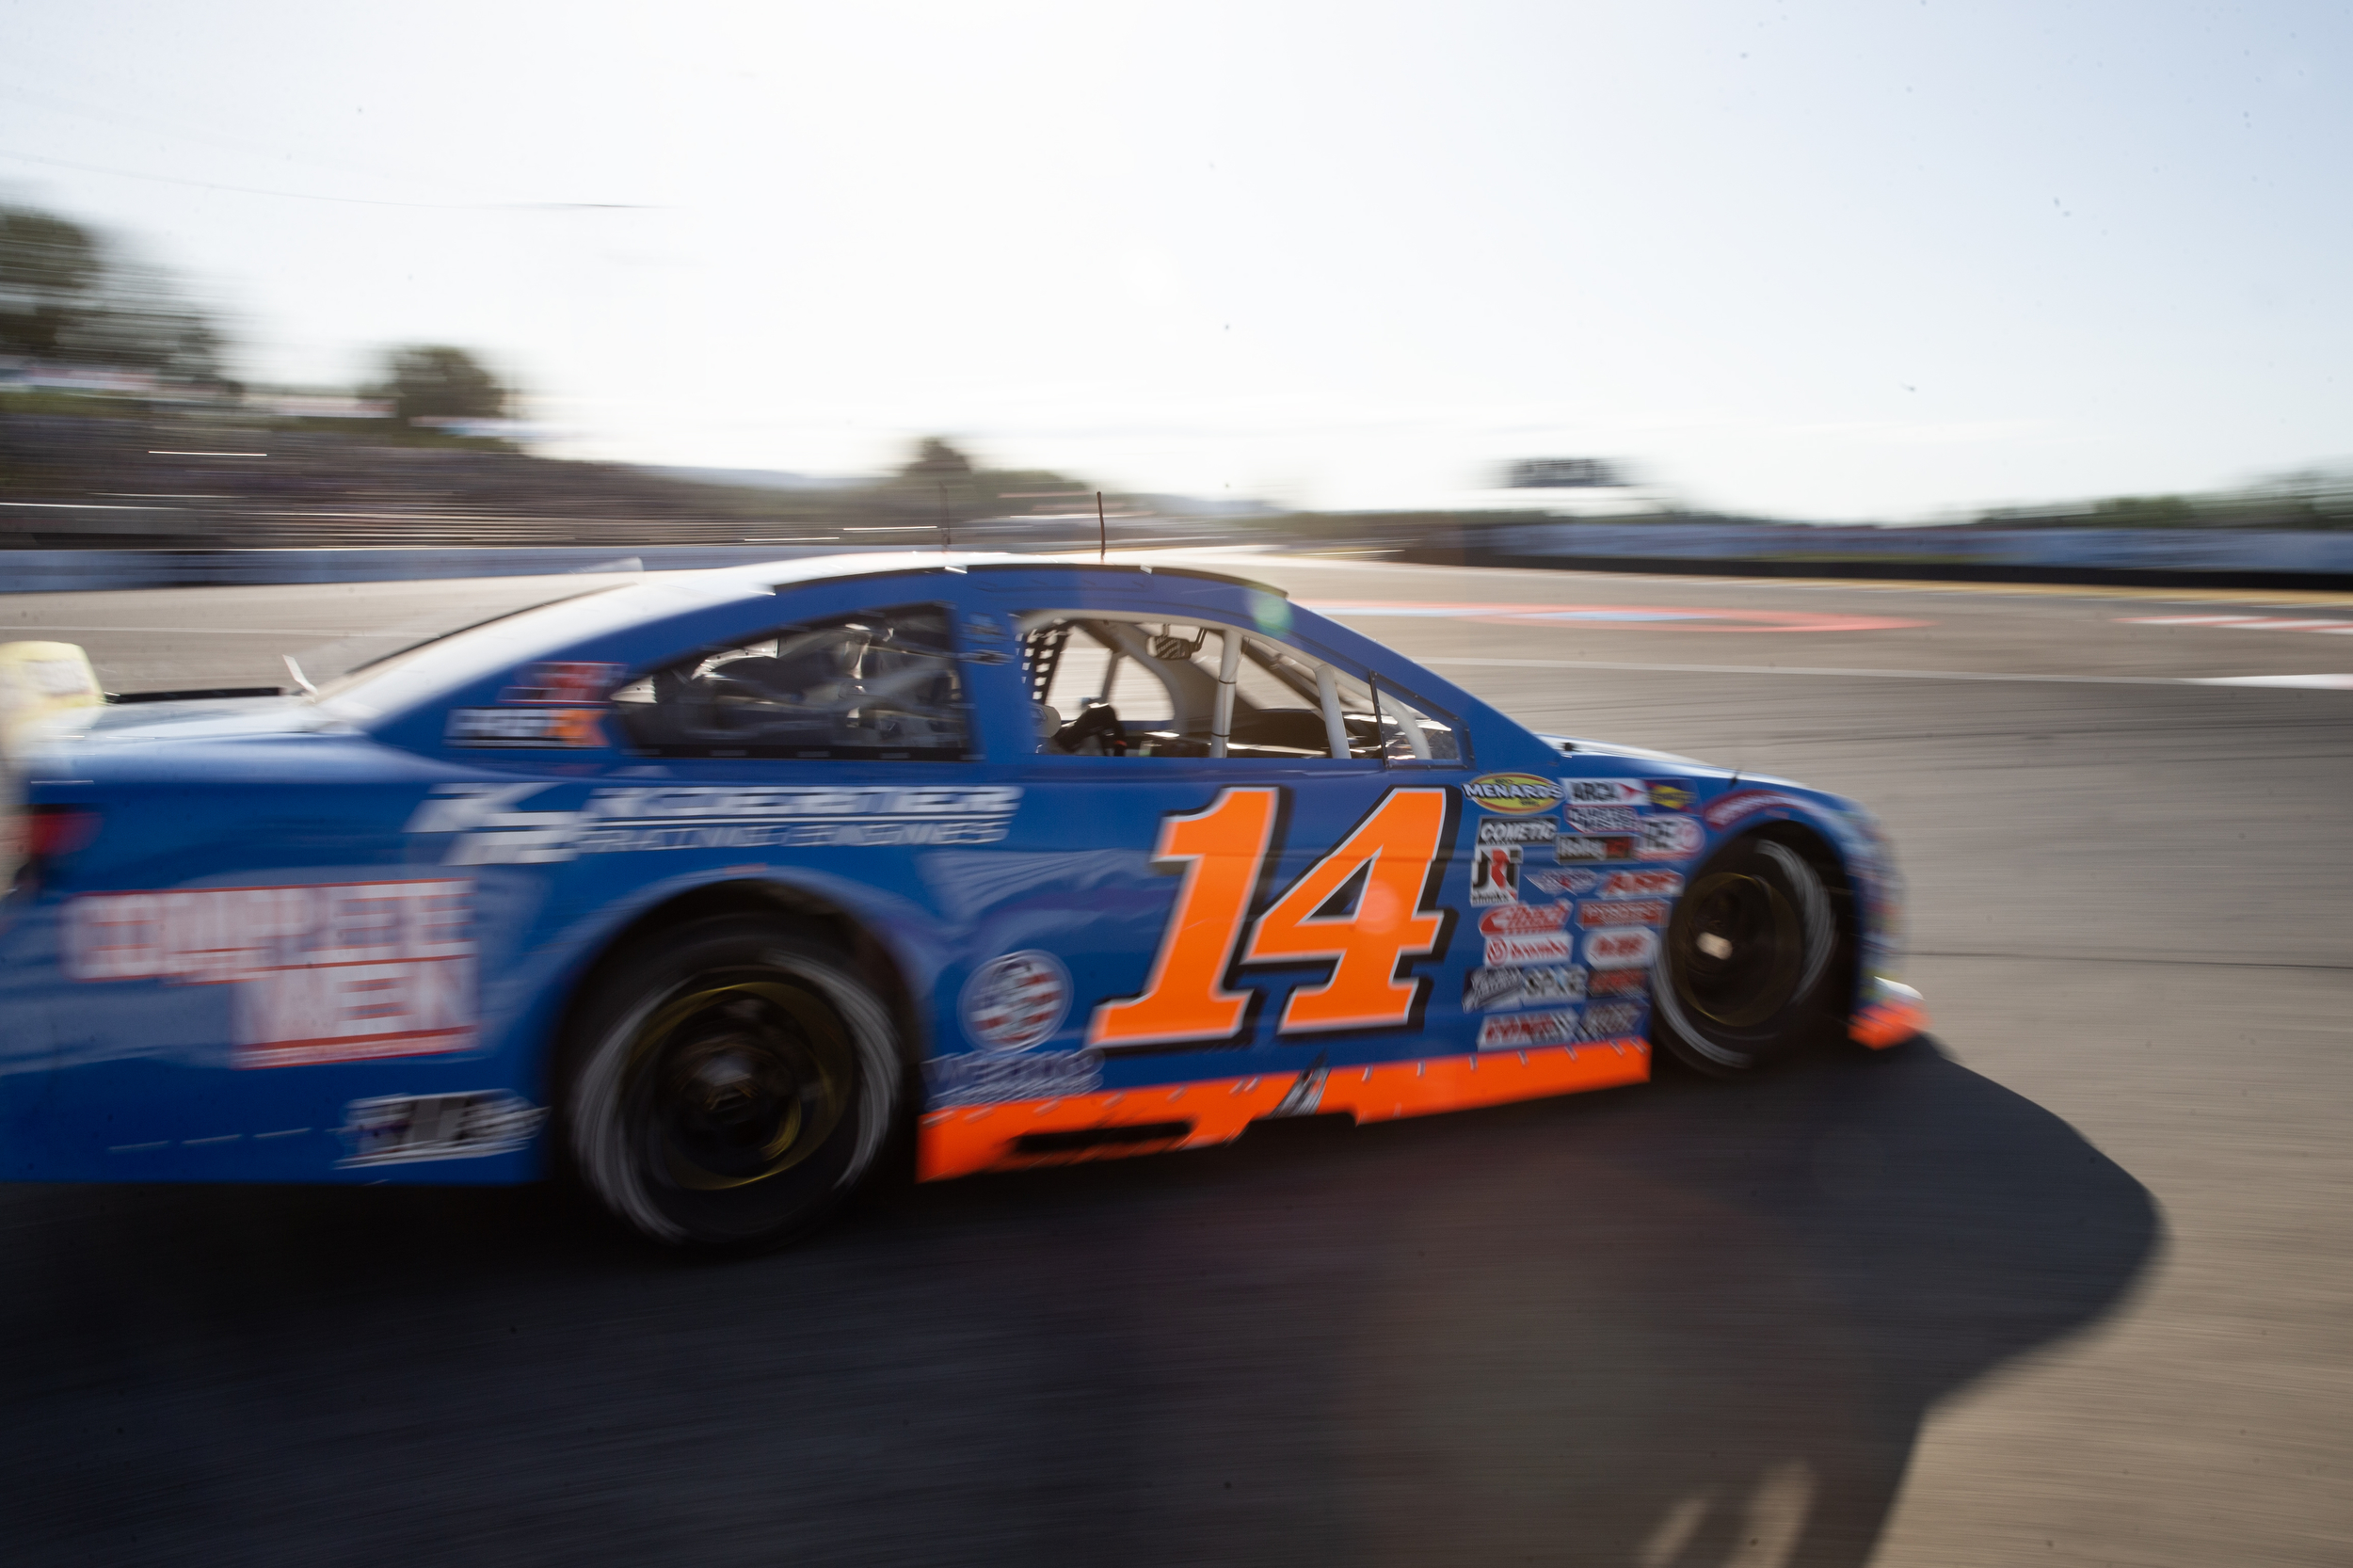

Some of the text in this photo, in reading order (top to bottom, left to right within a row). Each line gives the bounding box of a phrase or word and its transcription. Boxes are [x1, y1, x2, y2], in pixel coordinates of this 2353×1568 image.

[1461, 782, 1564, 800] MENARDS
[1481, 822, 1558, 840] COMETIC
[1086, 786, 1455, 1048] 14
